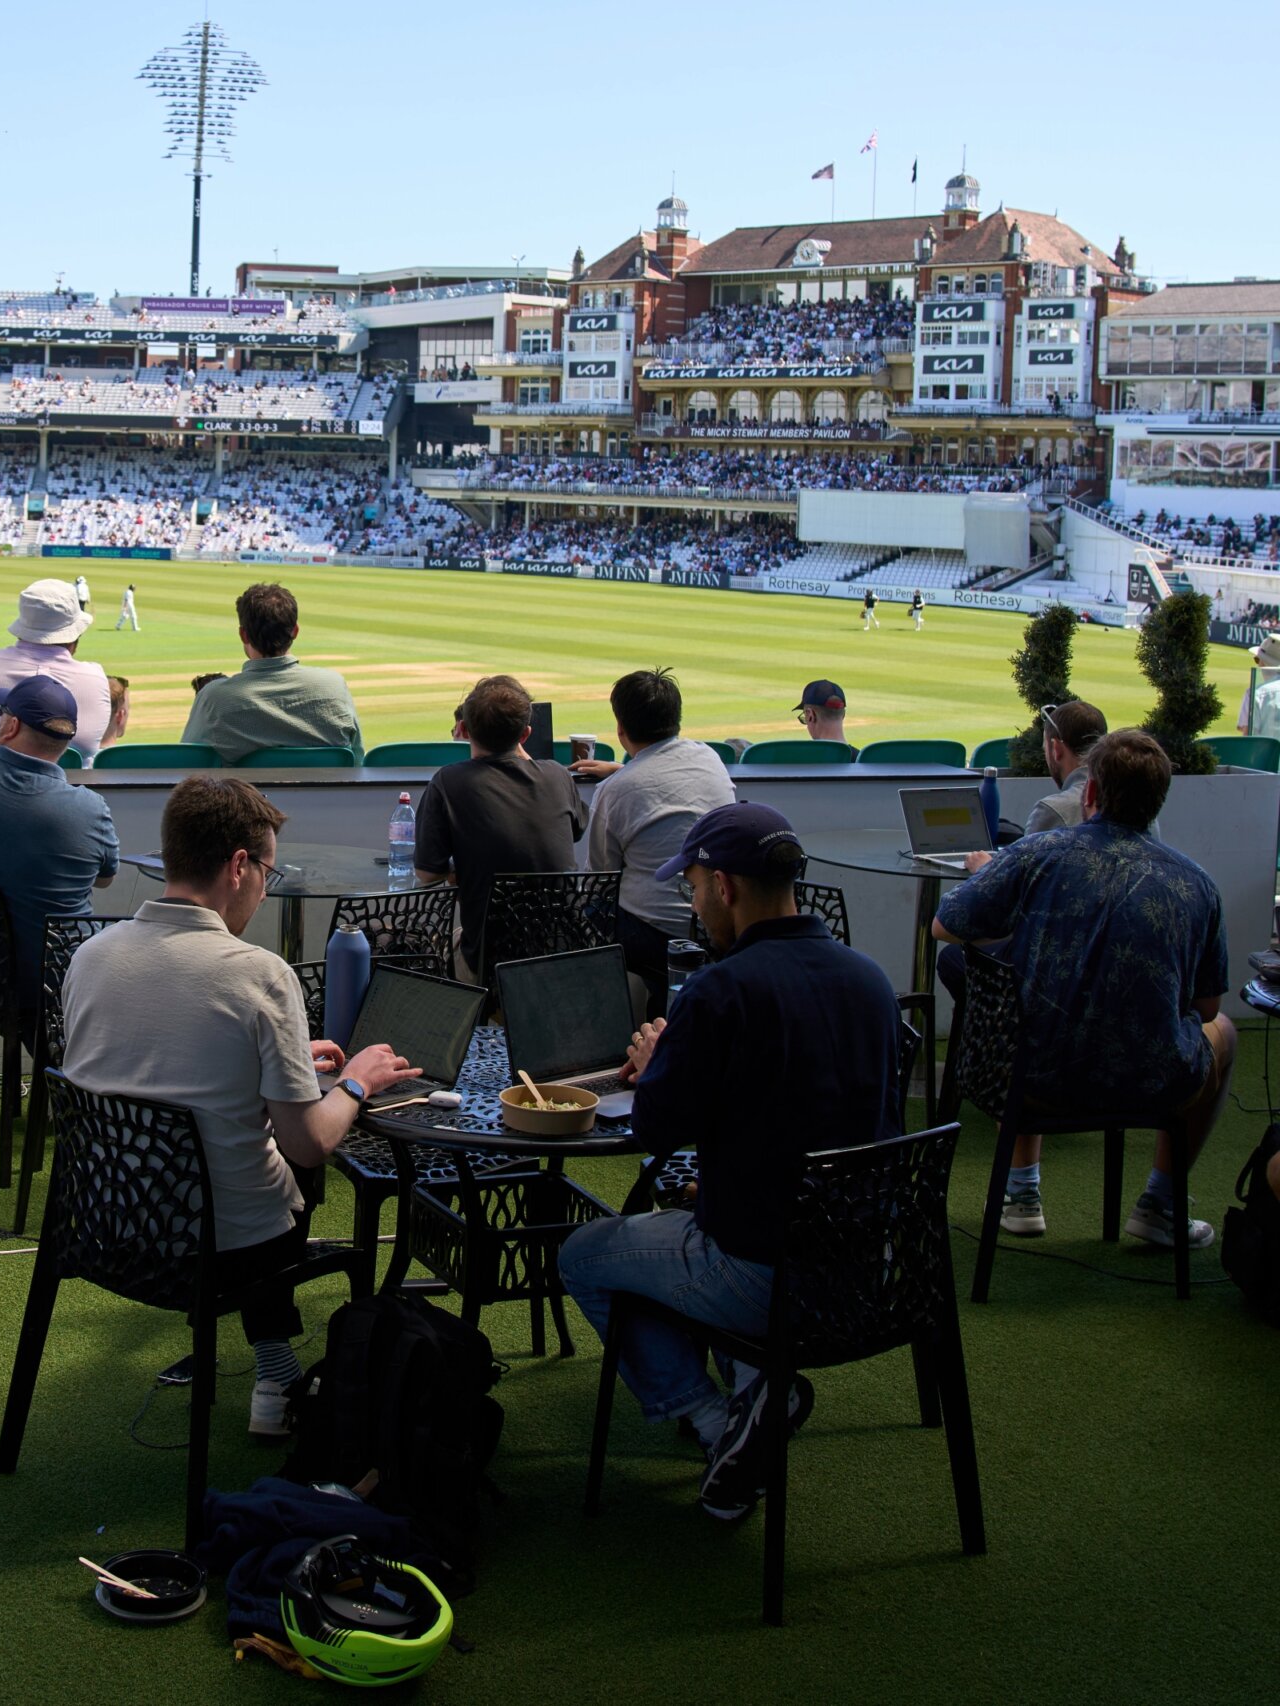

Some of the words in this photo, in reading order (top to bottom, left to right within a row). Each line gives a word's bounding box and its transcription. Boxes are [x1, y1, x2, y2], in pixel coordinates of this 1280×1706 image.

[933, 305, 973, 319] KIA
[1038, 306, 1065, 317] KIA
[576, 318, 608, 330] KIA
[33, 329, 61, 338] KIA
[85, 330, 113, 339] KIA
[136, 332, 165, 341] KIA
[188, 333, 216, 342] KIA
[239, 334, 267, 343] KIA
[290, 335, 318, 344] KIA
[1038, 352, 1065, 362] KIA
[576, 363, 608, 375] KIA
[933, 358, 973, 371] KIA
[650, 370, 675, 378] KIA
[680, 369, 705, 378] KIA
[718, 369, 744, 377] KIA
[749, 368, 776, 377] KIA
[790, 368, 818, 377] KIA
[823, 368, 852, 376] KIA
[204, 422, 232, 431] CLARK
[690, 428, 705, 438] THE
[707, 428, 730, 438] MICKY
[732, 428, 768, 438] STEWART
[770, 429, 811, 438] MEMBERS'
[813, 429, 850, 439] PAVILION
[257, 554, 282, 563] Fidelity
[284, 555, 309, 564] Energy
[429, 558, 448, 567] KIA
[460, 560, 480, 569] KIA
[504, 562, 524, 571] KIA
[527, 564, 548, 573] KIA
[551, 565, 572, 574] KIA
[597, 566, 613, 579] JM
[616, 566, 646, 581] FINN
[669, 570, 686, 584] JM
[689, 571, 720, 587] FINN
[769, 577, 830, 594] Rothesay
[848, 585, 893, 599] Protcting
[896, 588, 936, 600] Penns
[954, 590, 1021, 609] Rothesay
[1227, 624, 1243, 642] JM
